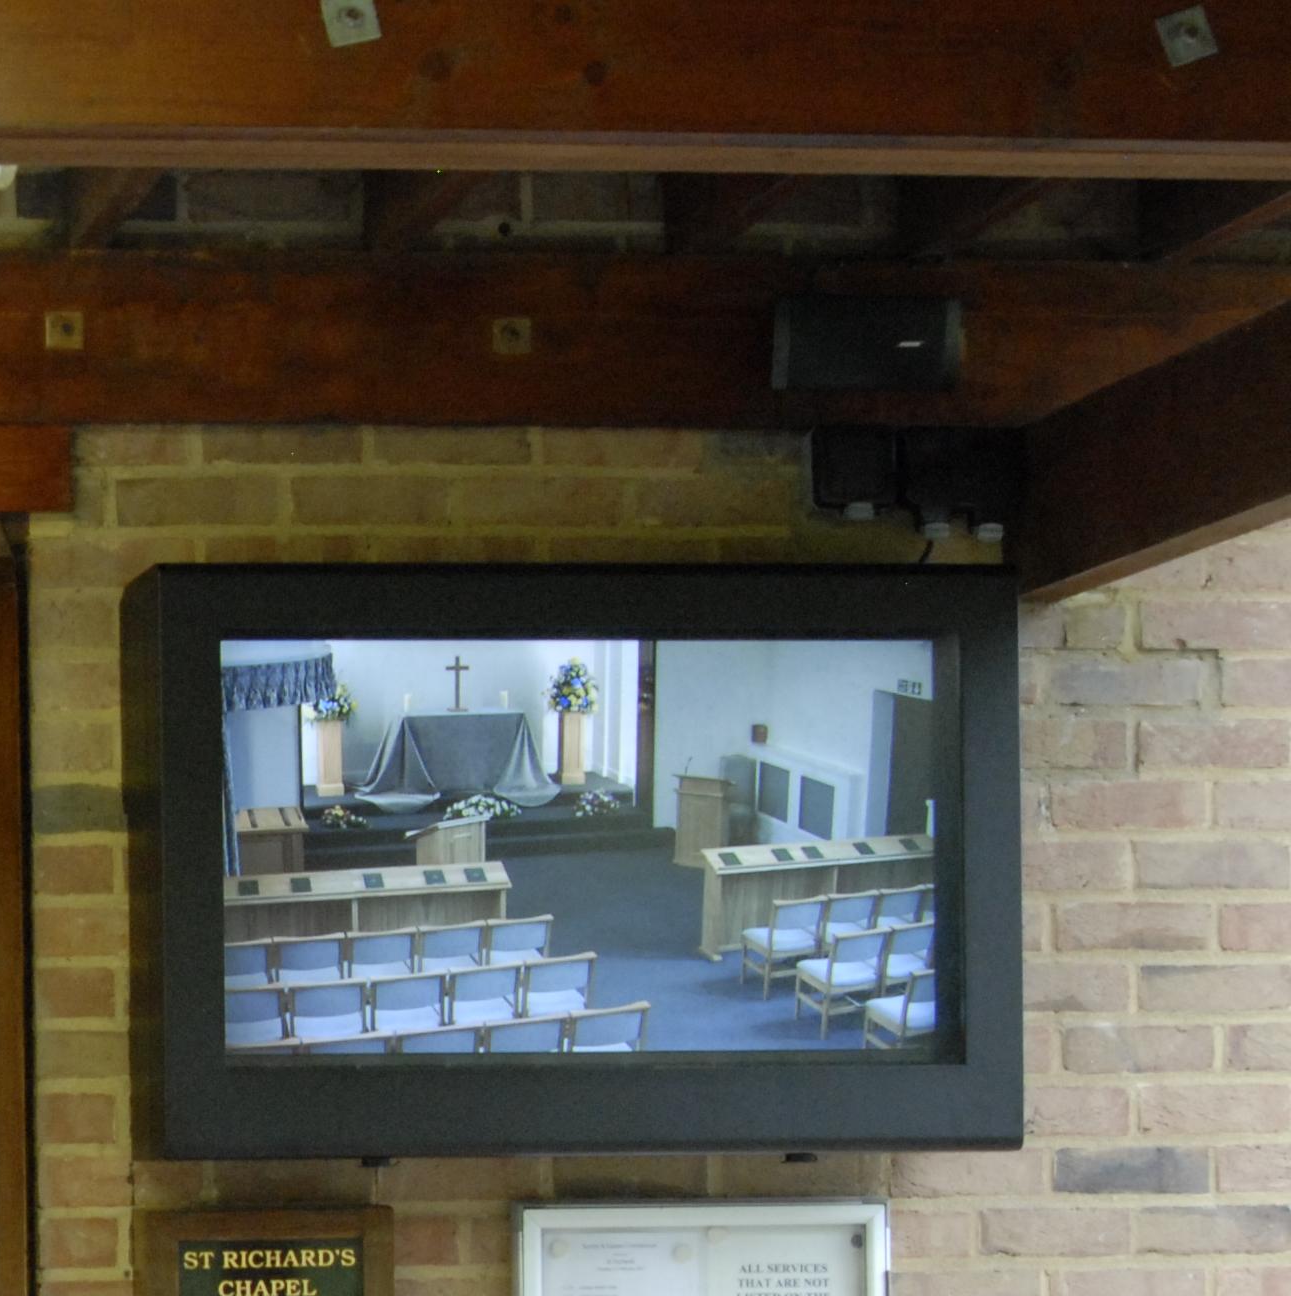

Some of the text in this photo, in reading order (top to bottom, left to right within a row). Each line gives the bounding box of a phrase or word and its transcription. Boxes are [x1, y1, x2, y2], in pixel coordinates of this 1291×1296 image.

[183, 1248, 357, 1270] ST RICHARD'S
[739, 1263, 829, 1273] ALL SERVICES
[737, 1278, 830, 1288] THAT ARE NOT
